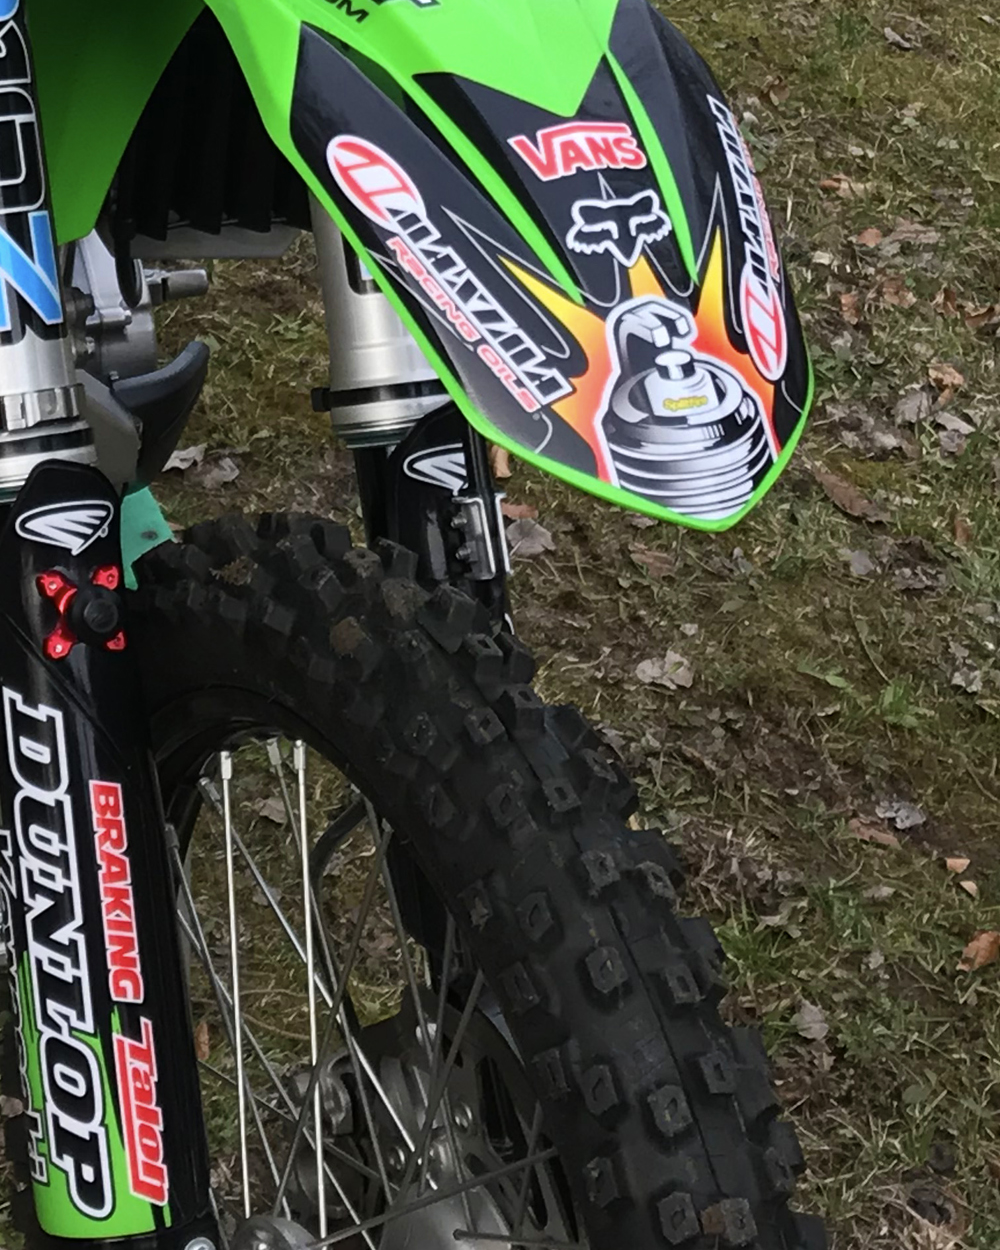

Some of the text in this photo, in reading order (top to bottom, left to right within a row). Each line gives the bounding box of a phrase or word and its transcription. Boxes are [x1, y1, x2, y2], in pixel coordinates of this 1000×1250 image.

[509, 121, 646, 181] VANS
[383, 198, 577, 407] MAXIMA
[475, 345, 542, 413] OILS
[2, 687, 114, 1221] DUNLOP
[89, 778, 145, 1004] BRAKING
[112, 1017, 169, 1206] Talon
